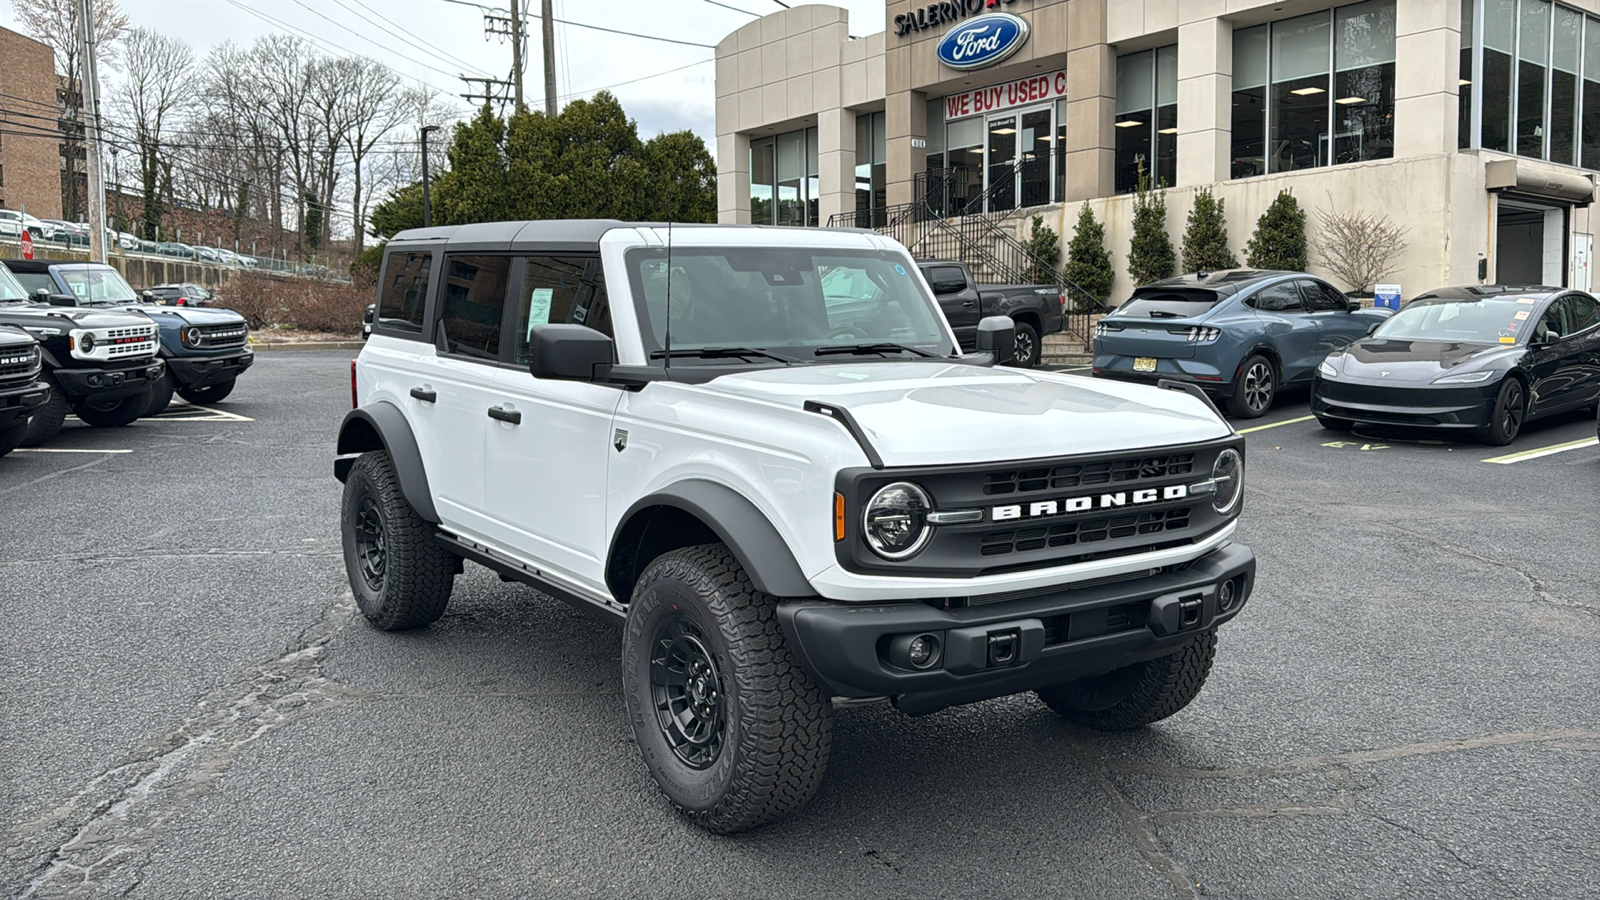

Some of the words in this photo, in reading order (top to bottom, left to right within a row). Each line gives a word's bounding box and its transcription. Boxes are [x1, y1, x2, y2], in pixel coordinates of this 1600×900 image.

[893, 0, 984, 36] SALERNO
[952, 25, 1002, 60] Ford
[947, 94, 969, 118] WE
[974, 86, 1004, 112] BUY
[1008, 76, 1050, 106] USED
[1054, 71, 1067, 95] C
[992, 485, 1187, 521] BRONCO
